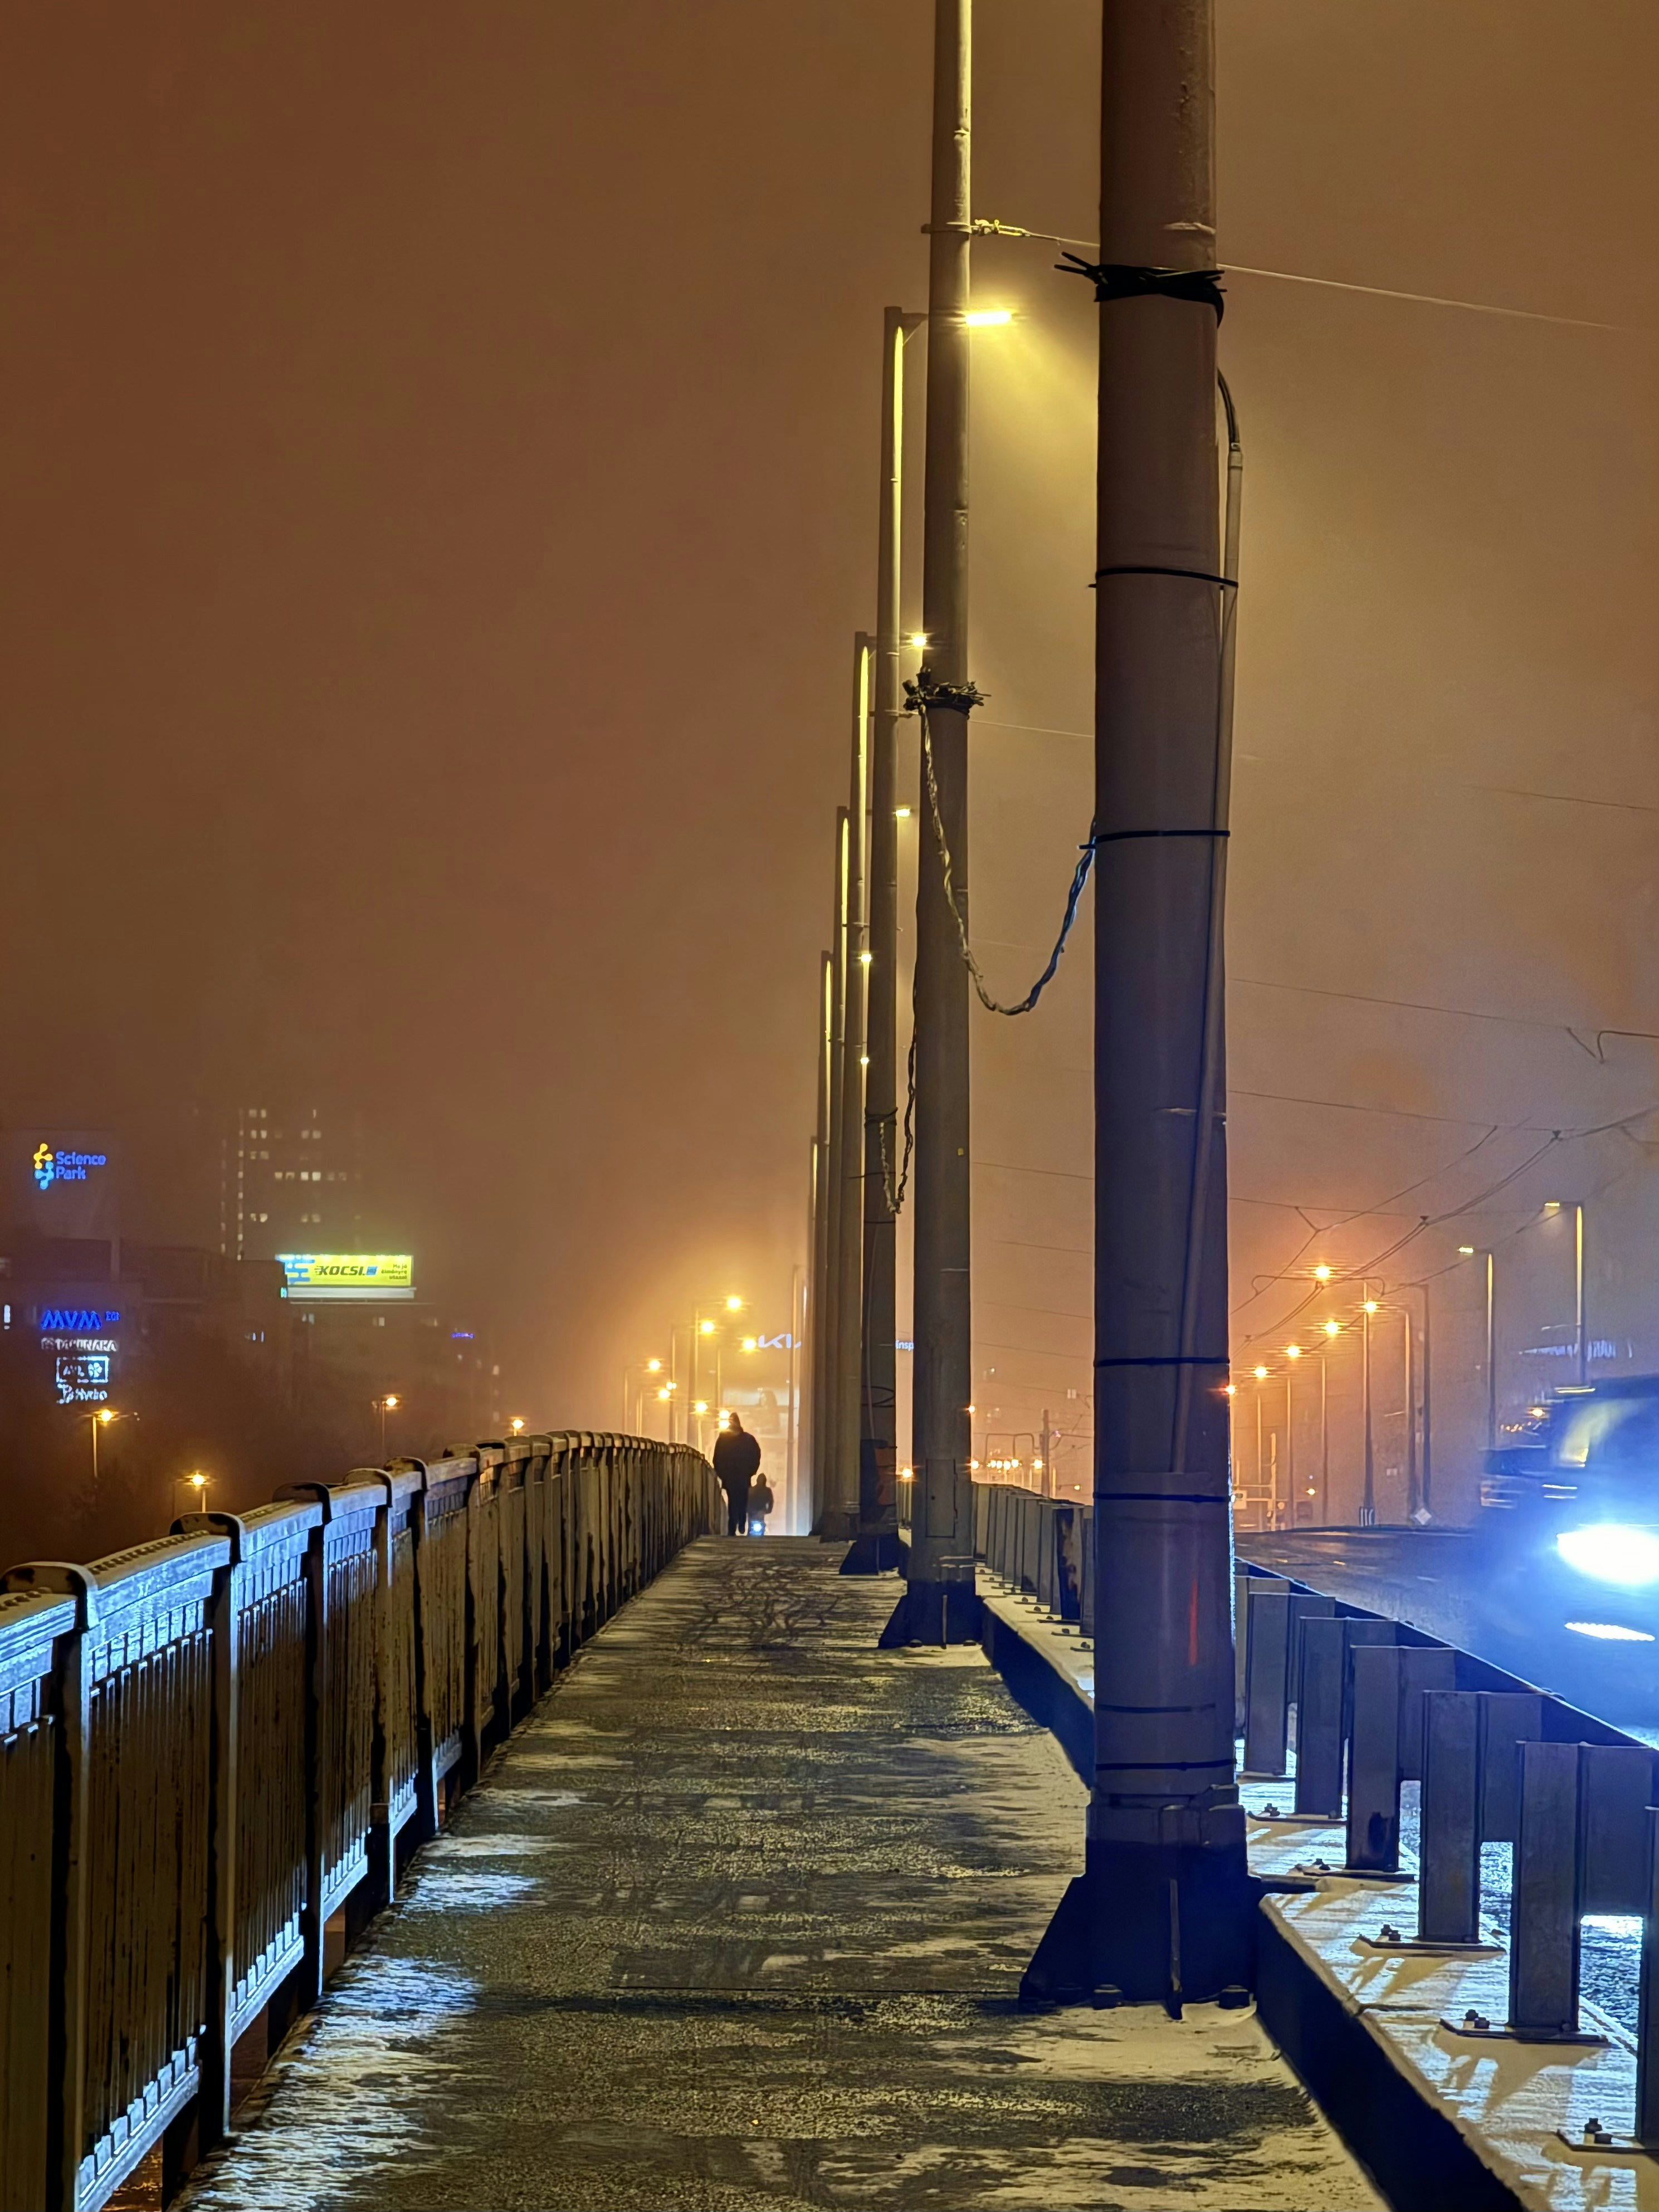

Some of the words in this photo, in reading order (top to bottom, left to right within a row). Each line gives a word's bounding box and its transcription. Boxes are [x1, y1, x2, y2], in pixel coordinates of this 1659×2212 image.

[56, 1151, 106, 1165] Science
[56, 1166, 86, 1180] Park
[42, 1310, 101, 1330] MVM
